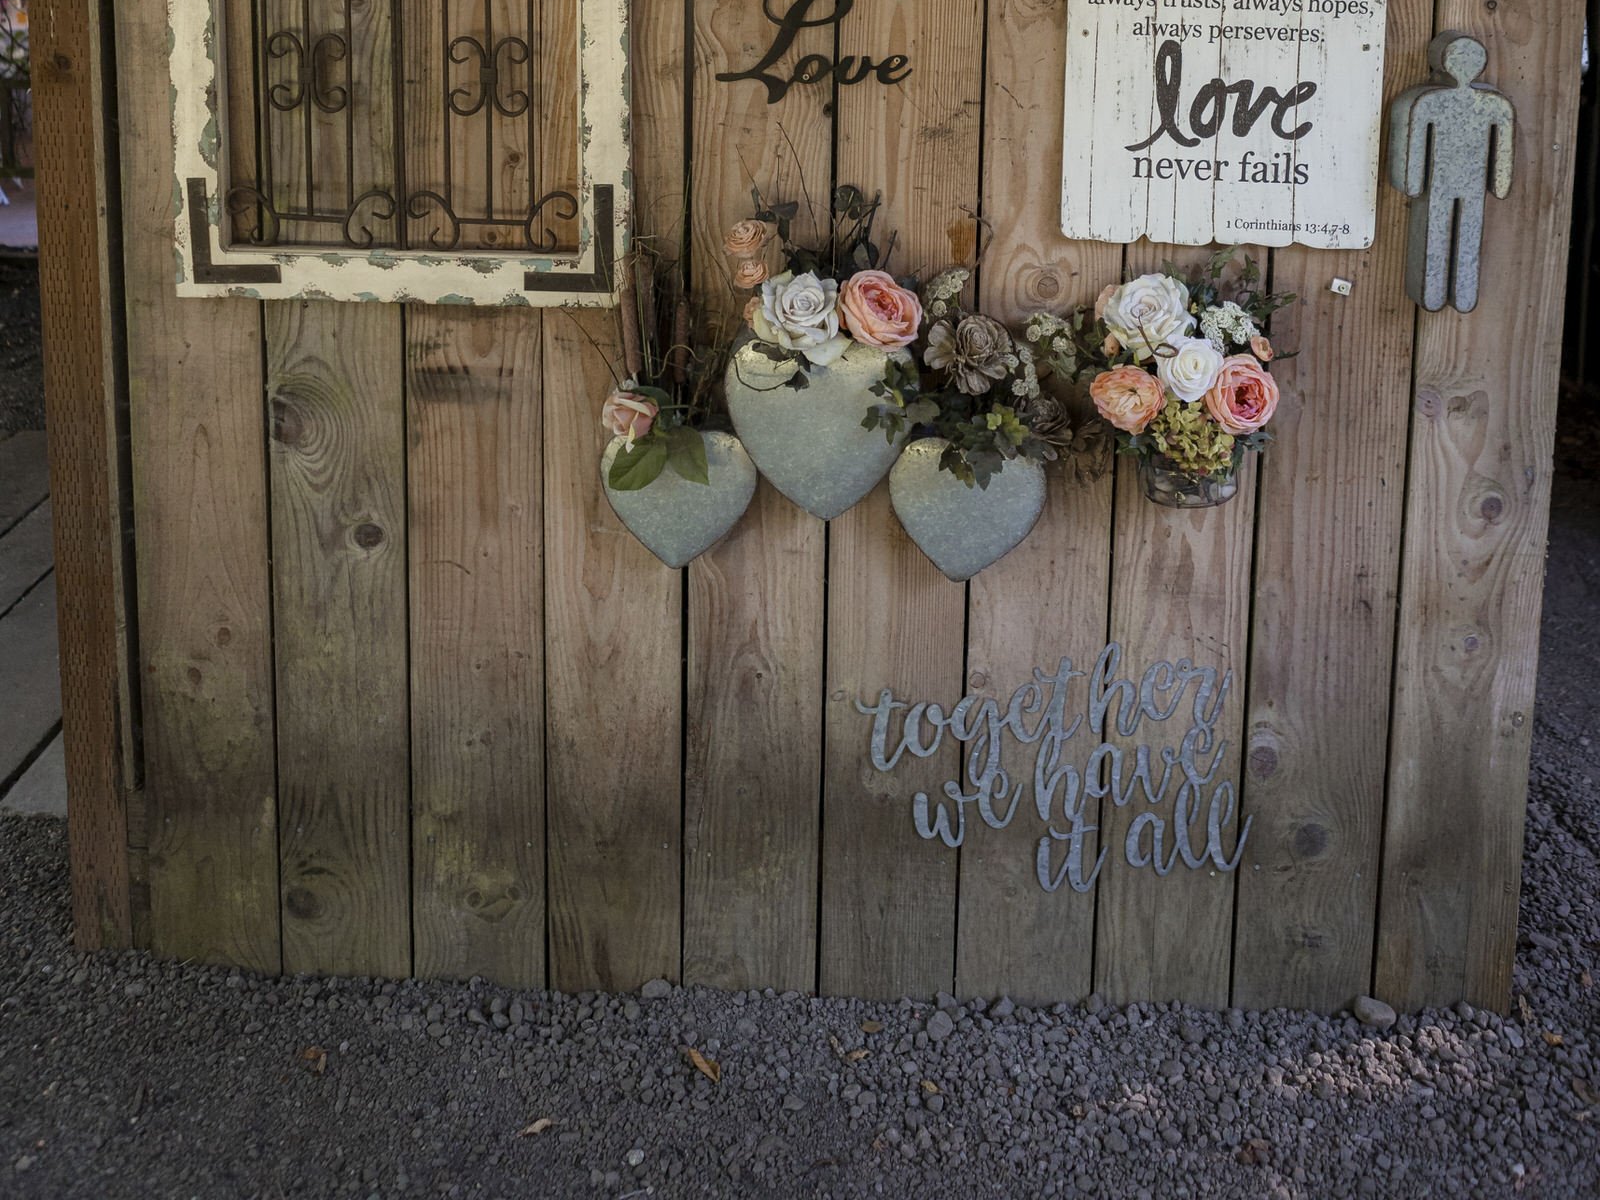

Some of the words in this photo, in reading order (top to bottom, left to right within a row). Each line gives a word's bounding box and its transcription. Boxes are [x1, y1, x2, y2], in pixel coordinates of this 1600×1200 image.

[1132, 16, 1202, 42] always
[1208, 24, 1325, 44] perseveres.
[1124, 40, 1318, 151] love
[1132, 156, 1230, 182] never
[1238, 151, 1310, 185] fails
[1226, 220, 1231, 229] 1
[1234, 218, 1301, 231] Corinthians
[1305, 223, 1351, 235] 13:4,7-8
[855, 641, 1232, 787] together
[913, 769, 1023, 848] we
[1035, 725, 1227, 822] have
[1037, 815, 1109, 893] it
[1125, 780, 1253, 876] all
